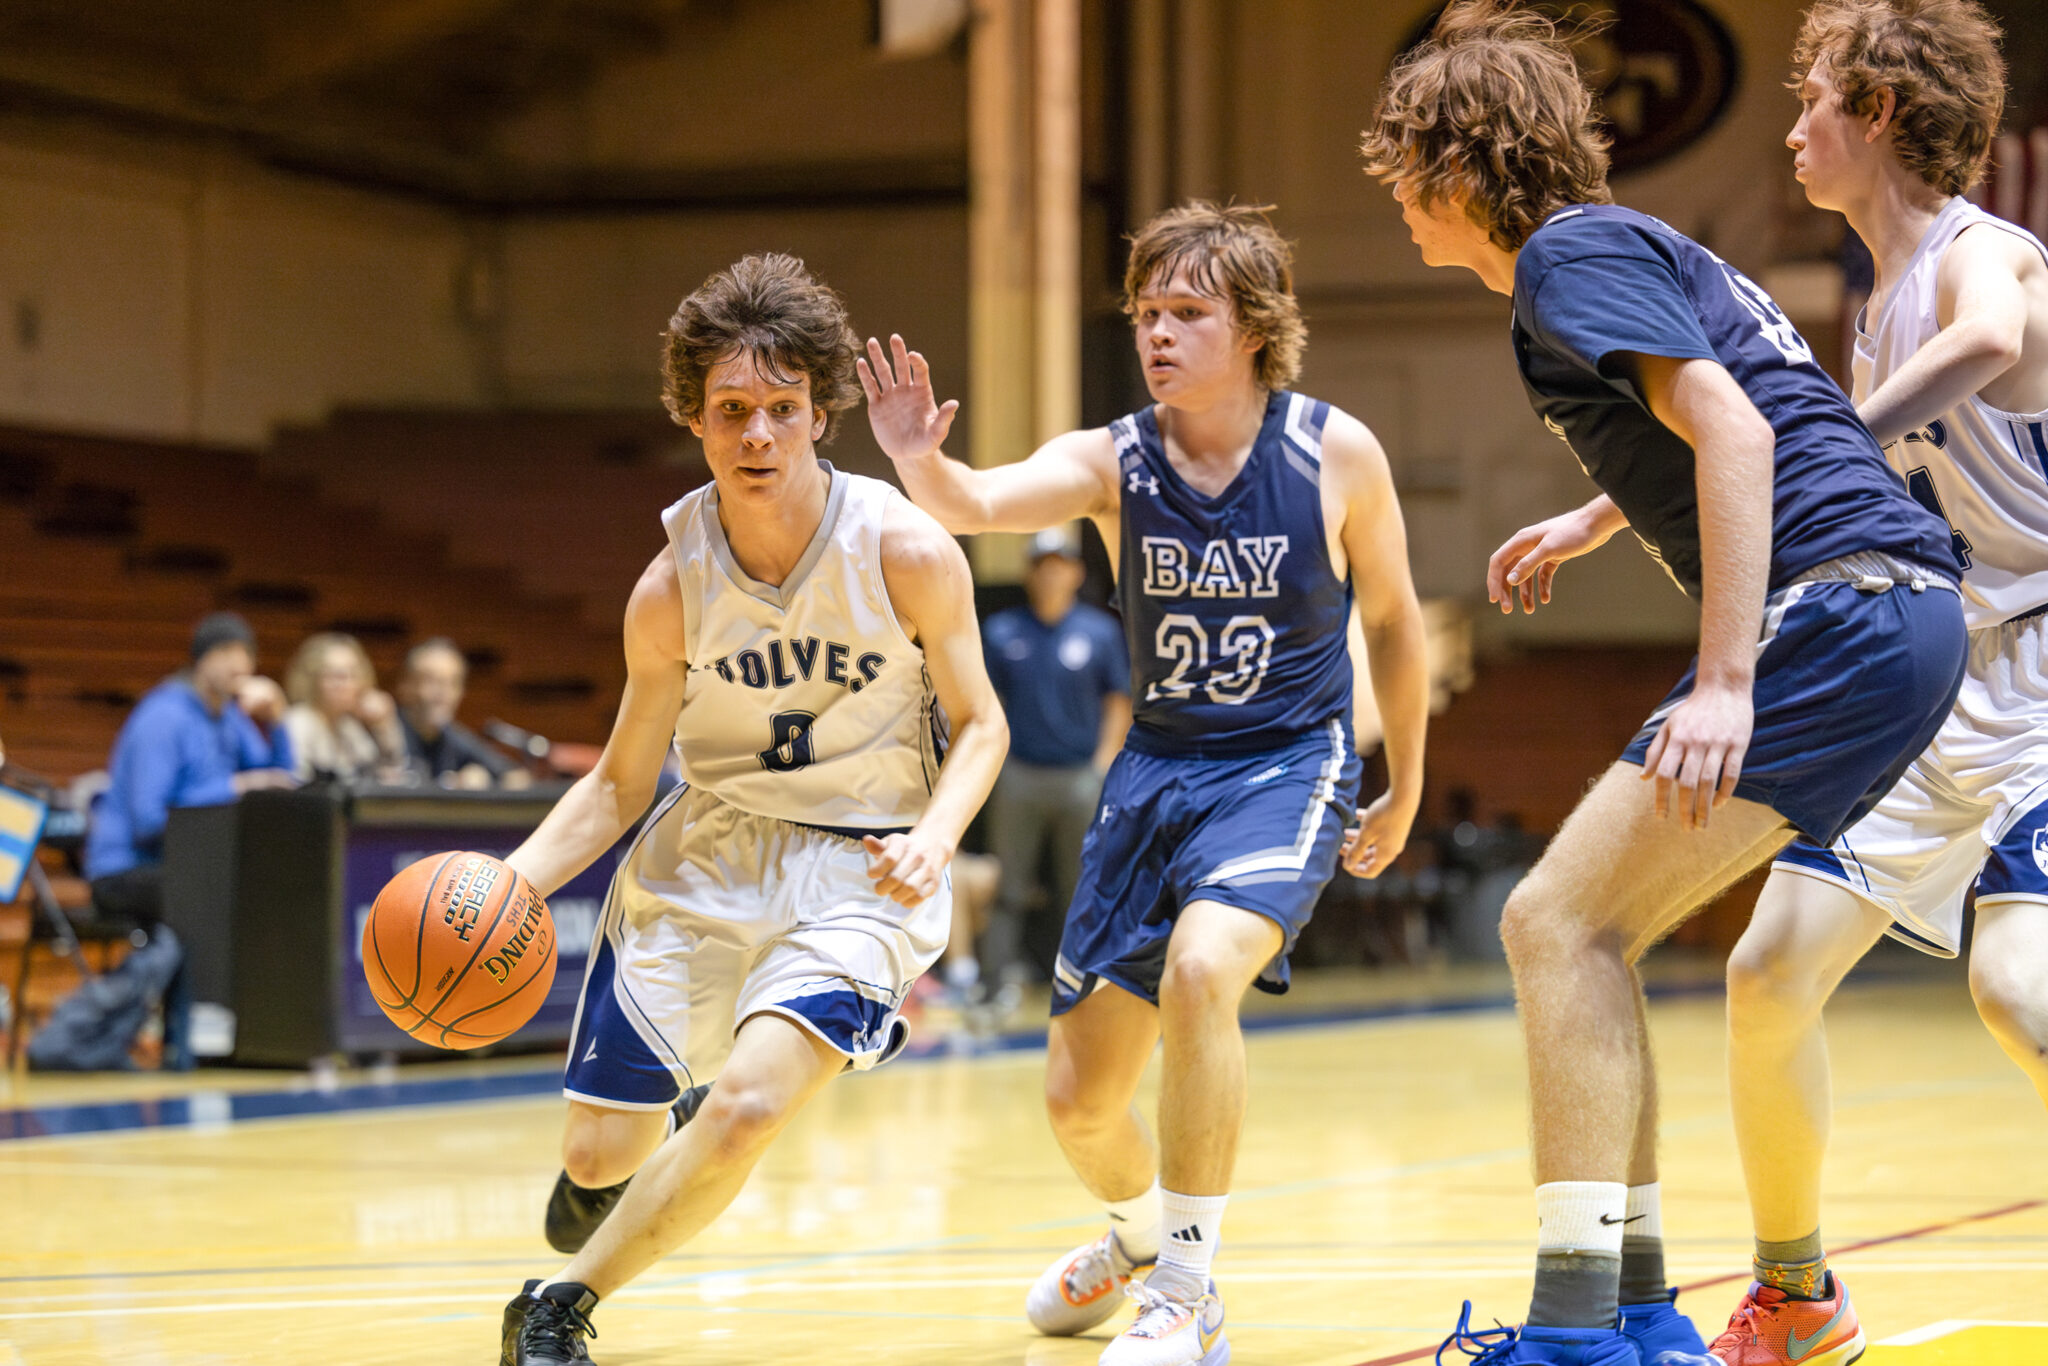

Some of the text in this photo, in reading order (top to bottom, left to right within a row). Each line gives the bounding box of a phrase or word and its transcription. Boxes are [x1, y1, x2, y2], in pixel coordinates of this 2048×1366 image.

[1142, 535, 1289, 598] BAY
[1145, 613, 1276, 705] 23
[756, 709, 817, 774] 0
[454, 859, 504, 943] LEGACY
